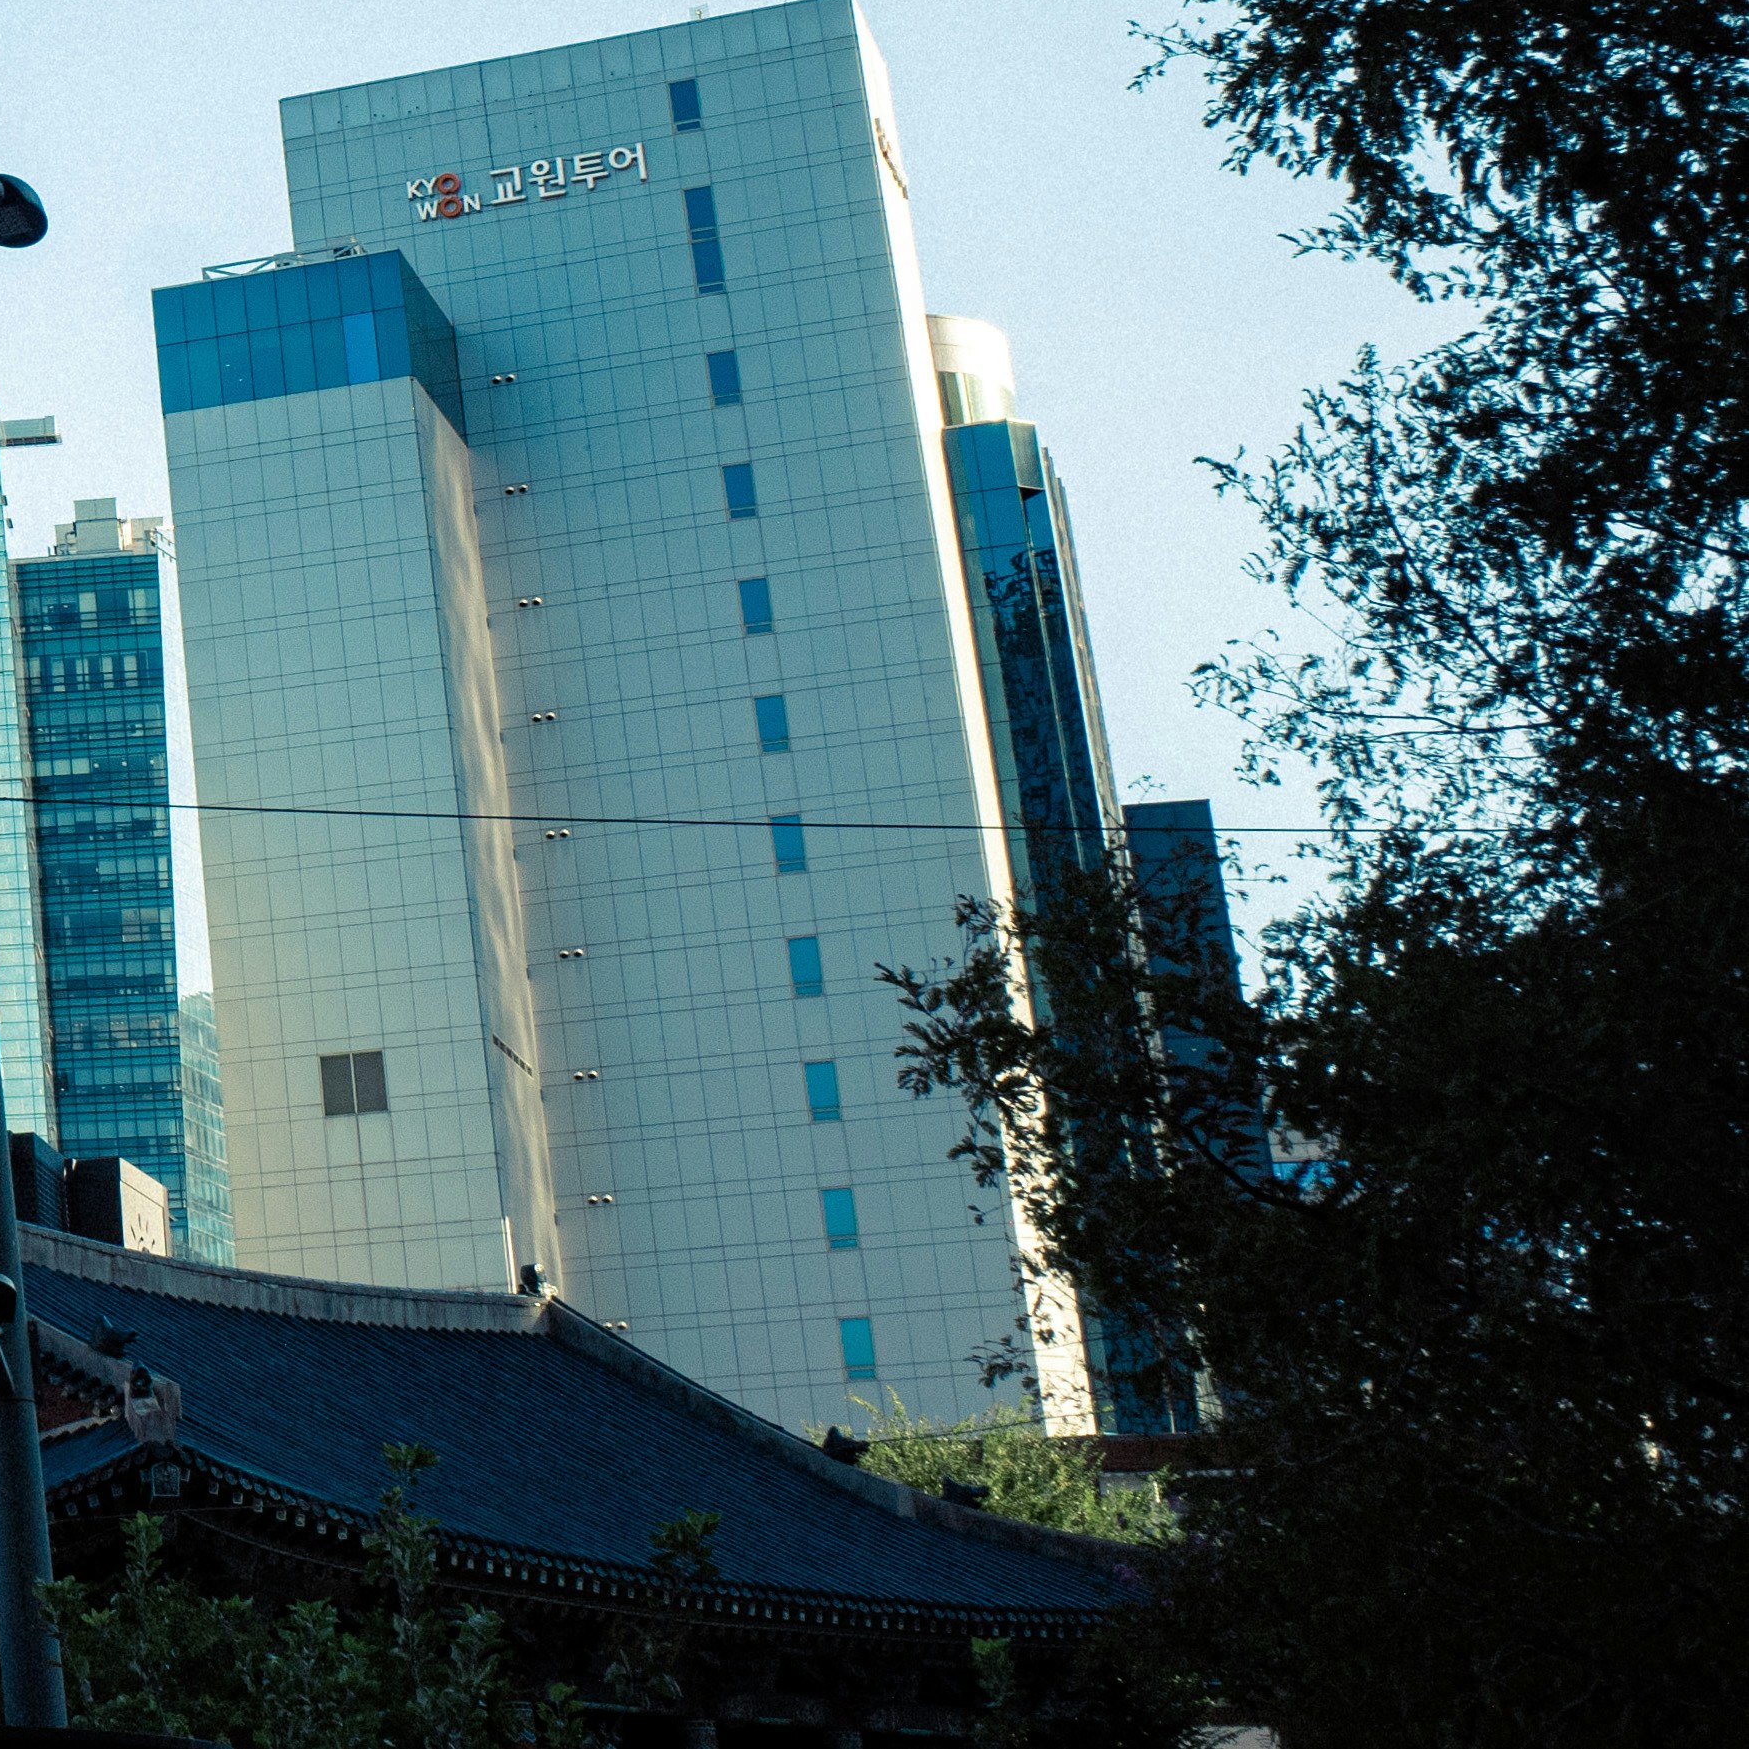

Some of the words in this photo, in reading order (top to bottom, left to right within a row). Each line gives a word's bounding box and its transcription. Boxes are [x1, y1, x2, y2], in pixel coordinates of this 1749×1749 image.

[406, 172, 461, 200] KYO
[490, 142, 648, 205] 교원투어
[416, 193, 481, 221] WON
